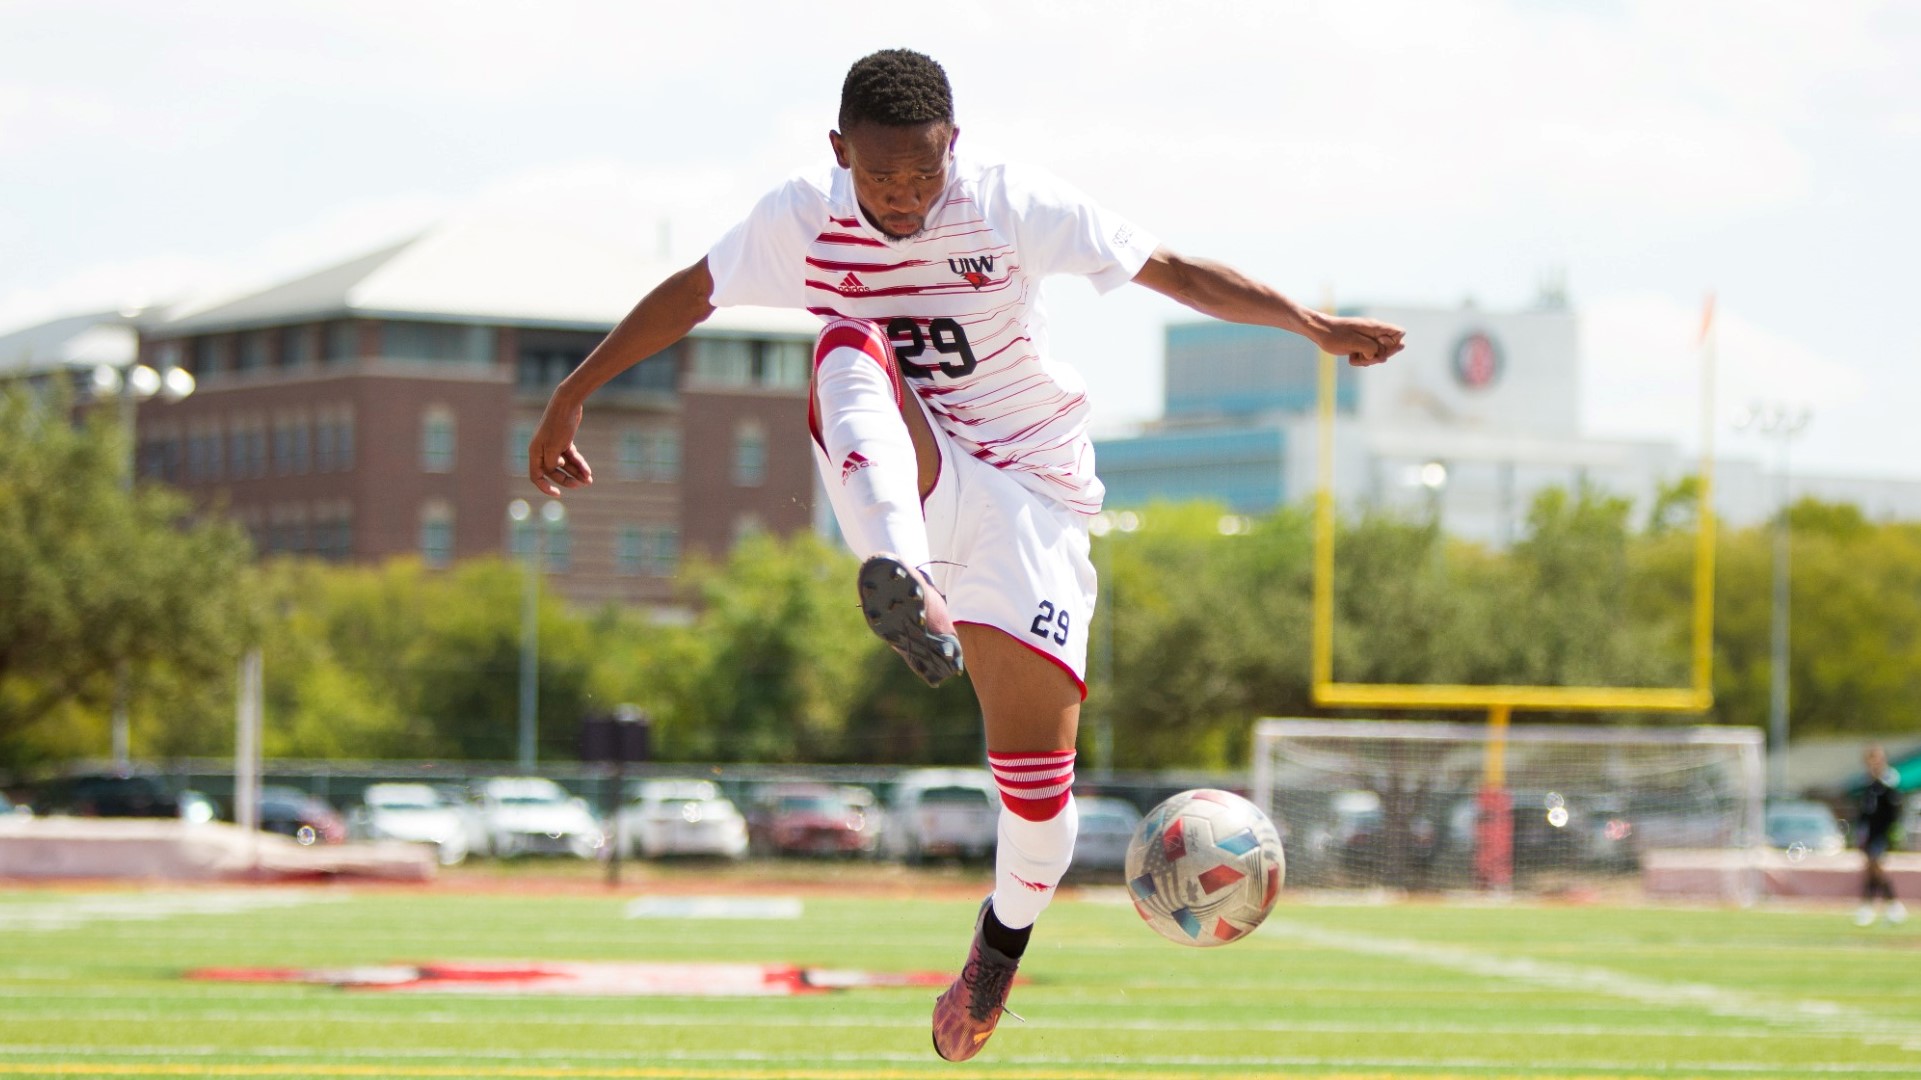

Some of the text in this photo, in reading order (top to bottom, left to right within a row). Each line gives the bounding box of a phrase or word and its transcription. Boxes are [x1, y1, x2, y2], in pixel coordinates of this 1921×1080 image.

[947, 255, 994, 275] UIW
[886, 317, 978, 380] 29
[1030, 599, 1070, 647] 29
